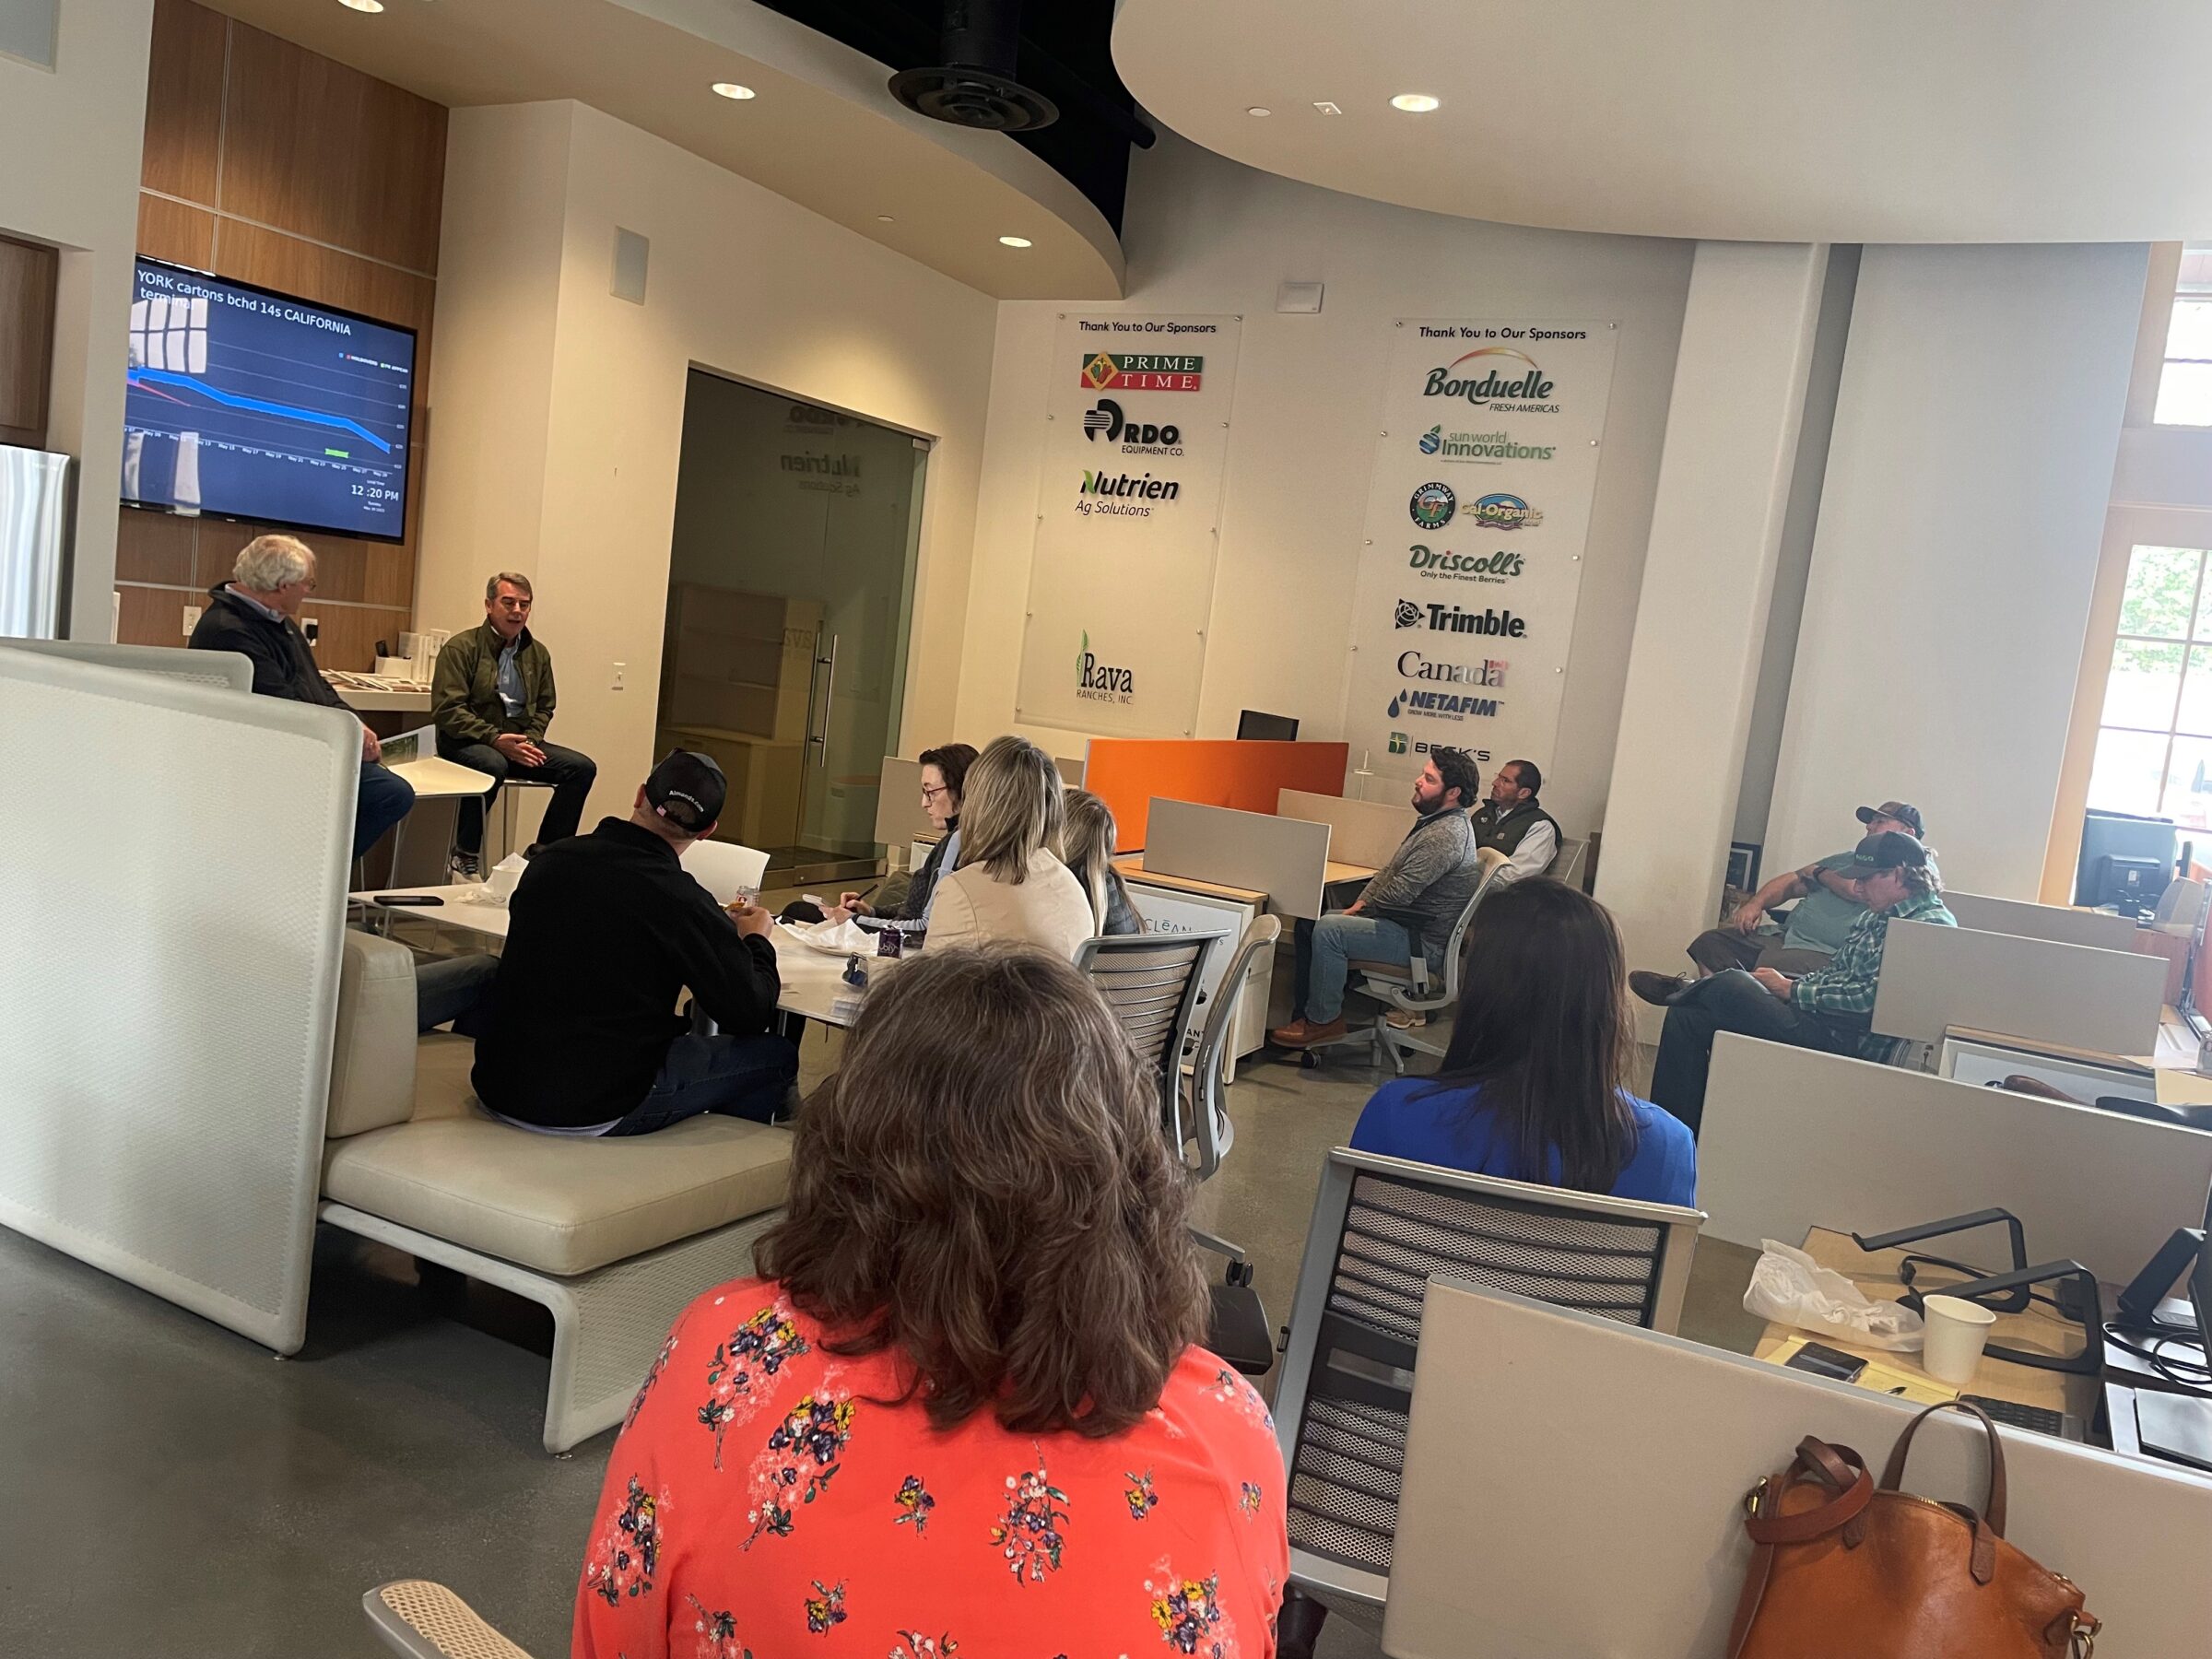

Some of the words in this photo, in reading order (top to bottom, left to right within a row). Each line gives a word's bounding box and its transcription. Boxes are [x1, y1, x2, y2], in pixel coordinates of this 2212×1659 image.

[137, 270, 173, 289] YORK
[177, 282, 224, 302] cartons
[228, 292, 257, 311] bchd
[260, 302, 281, 317] 14s
[284, 309, 351, 336] CALIFORNIA
[1079, 321, 1109, 332] Thank
[1112, 322, 1131, 333] You
[1133, 323, 1143, 333] to
[1145, 323, 1165, 333] Our
[1167, 323, 1217, 335] Sponsors
[1418, 326, 1455, 338] Thank
[1460, 327, 1481, 338] You
[1485, 328, 1497, 338] to
[1500, 327, 1525, 339] Our
[1528, 328, 1586, 342] Sponsors
[1124, 356, 1195, 371] PRIME
[1122, 373, 1194, 390] TIME
[1423, 367, 1554, 406] Bonduelle
[1489, 403, 1516, 412] FRESH
[1516, 404, 1559, 414] AMERICAS
[1122, 445, 1168, 456] EQUIPMENT
[1170, 447, 1184, 457] CO.
[1441, 440, 1552, 460] Innovations
[1079, 469, 1180, 500] Nutrien
[1413, 482, 1454, 502] GRIMMWAY
[384, 489, 399, 501] PM
[1075, 500, 1092, 516] Ag
[1094, 500, 1151, 517] Solutions
[1462, 502, 1543, 521] Cal-Organic
[1414, 516, 1446, 529] FARMS
[1409, 544, 1524, 577] Driscoll's
[1420, 570, 1438, 580] Only
[1439, 571, 1452, 581] the
[1453, 572, 1477, 582] Finest
[1478, 575, 1506, 584] Berries
[1427, 604, 1525, 638] Trimble
[1080, 652, 1133, 693] Rava
[1397, 651, 1505, 688] Canada
[1077, 688, 1115, 704] RANCHES,
[1409, 690, 1497, 717] NETAFIM
